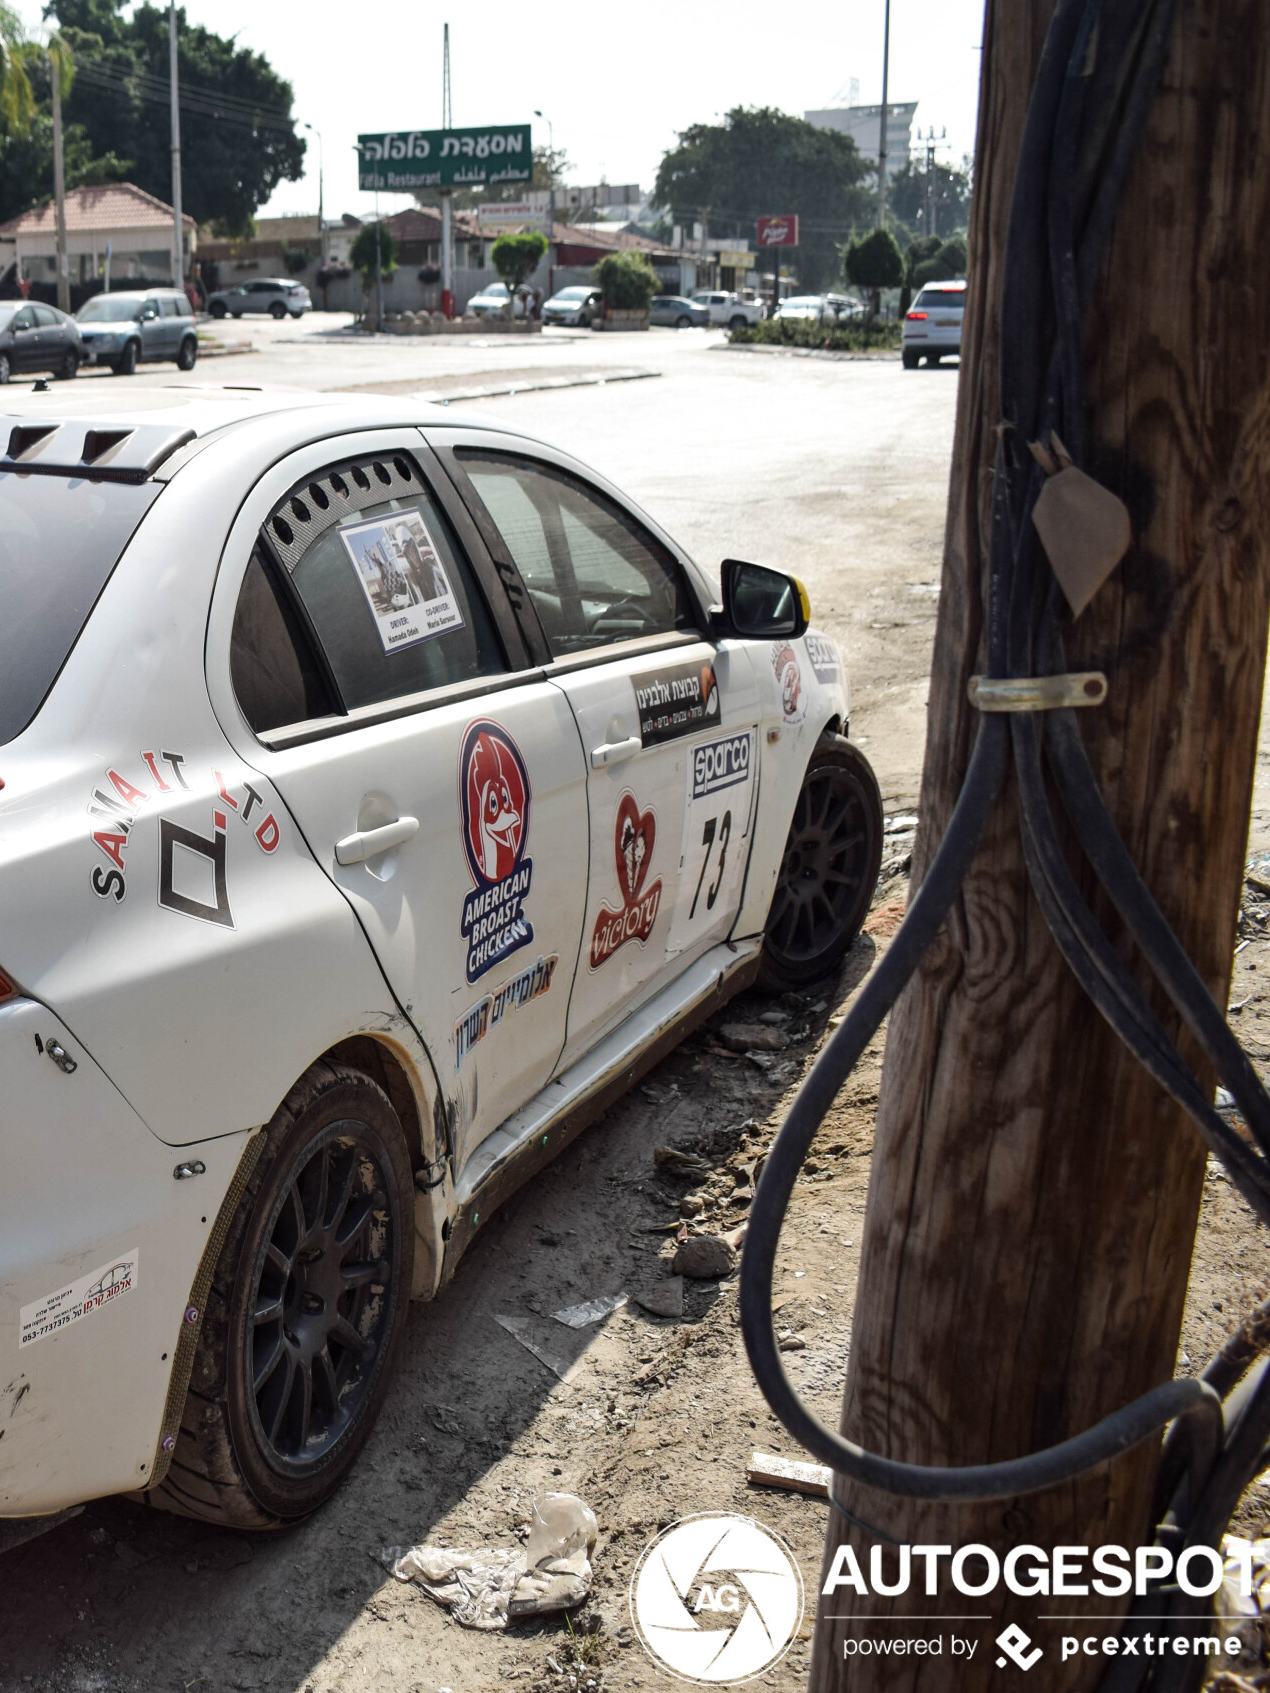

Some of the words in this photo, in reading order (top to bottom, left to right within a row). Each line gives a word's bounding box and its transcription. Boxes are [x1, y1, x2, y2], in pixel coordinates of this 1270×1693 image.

[364, 132, 430, 161] פלפלה
[440, 133, 523, 158] מסעדת
[387, 170, 441, 187] Restaurant
[388, 631, 407, 643] Hamada
[406, 627, 420, 637] Odeh
[389, 616, 410, 630] DRIVER:
[672, 676, 700, 701] קבוצת
[695, 737, 749, 793] sparco
[212, 769, 280, 853] LTD
[689, 810, 732, 919] 73
[464, 867, 529, 927] AMERICAN
[472, 896, 520, 946] BROAST
[469, 918, 528, 973] CHICKEN
[456, 1001, 489, 1069] השרון
[106, 1278, 132, 1298] אלמוג
[83, 1294, 105, 1315] קרמן
[22, 1315, 71, 1343] 053-7737375
